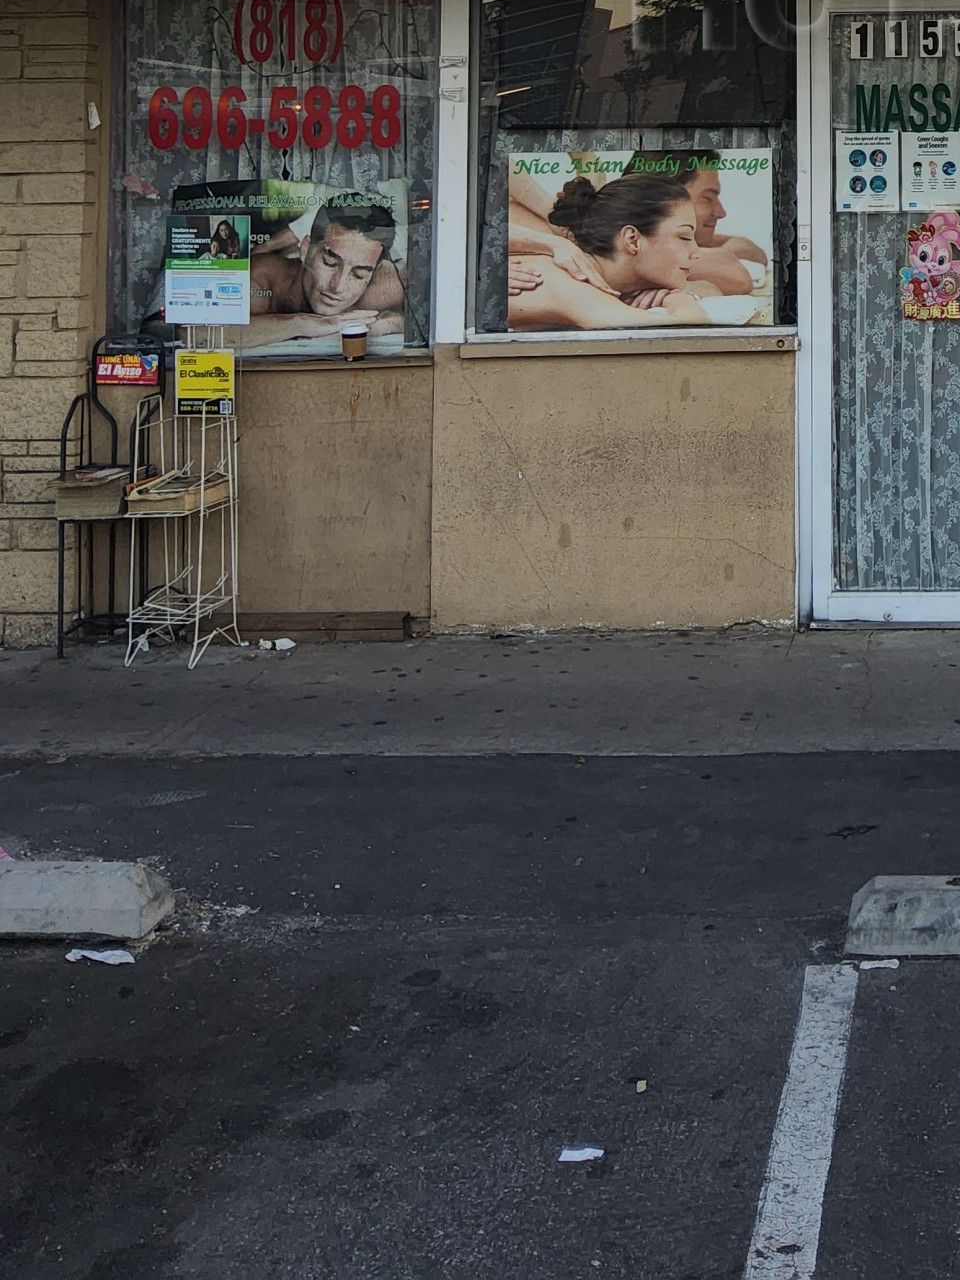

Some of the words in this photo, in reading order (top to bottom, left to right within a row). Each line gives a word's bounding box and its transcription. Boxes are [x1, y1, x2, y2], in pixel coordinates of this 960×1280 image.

[148, 84, 401, 150] 696-5888
[513, 157, 560, 176] Nice
[566, 158, 626, 175] Asian
[624, 154, 682, 178] Body
[685, 156, 770, 176] Massage
[175, 195, 246, 212] PROFESSIONAL
[248, 195, 329, 208] RELAXATION
[332, 195, 397, 209] MASSAGE
[98, 364, 112, 376] El
[112, 364, 142, 378] Aviso
[180, 370, 187, 378] El
[188, 369, 230, 378] Clasificado
